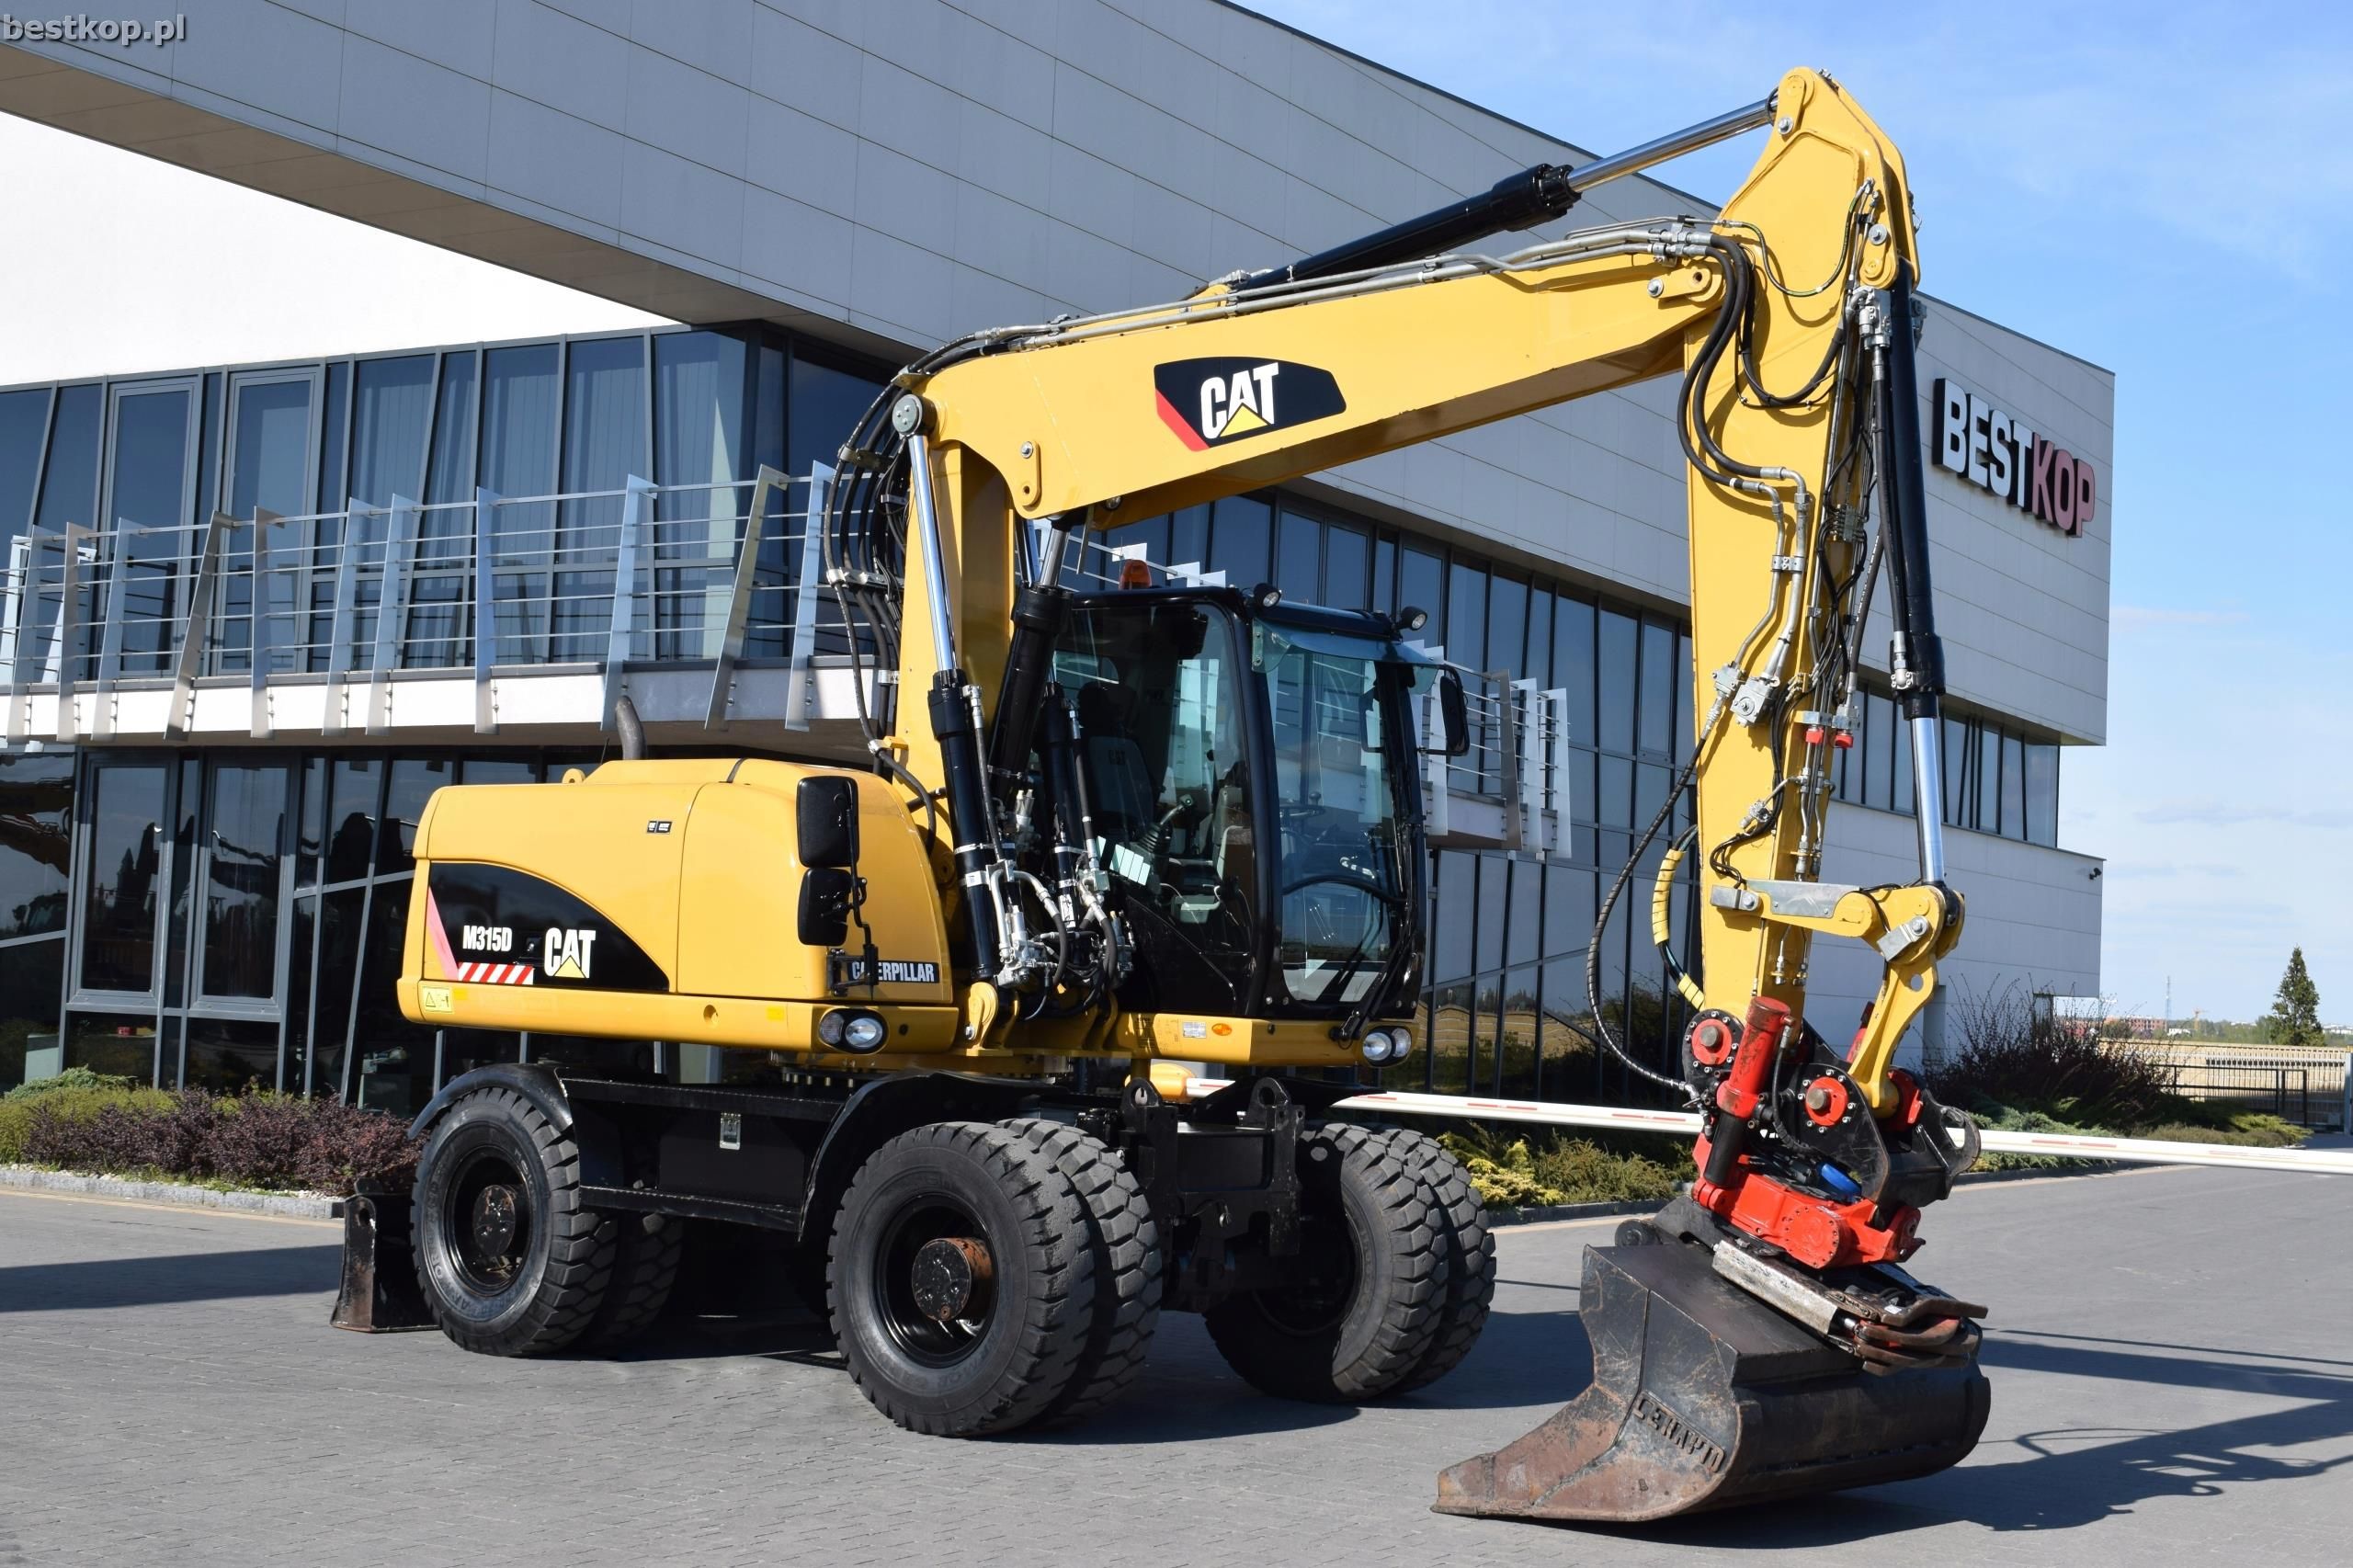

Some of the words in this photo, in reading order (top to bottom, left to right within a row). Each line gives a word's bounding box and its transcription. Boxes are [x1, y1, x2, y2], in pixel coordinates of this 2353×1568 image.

[1200, 362, 1279, 439] CAT
[1933, 378, 2096, 538] BESTKOP
[462, 925, 513, 952] M315D
[544, 927, 596, 979] CAT
[851, 960, 935, 982] CERPILLAR
